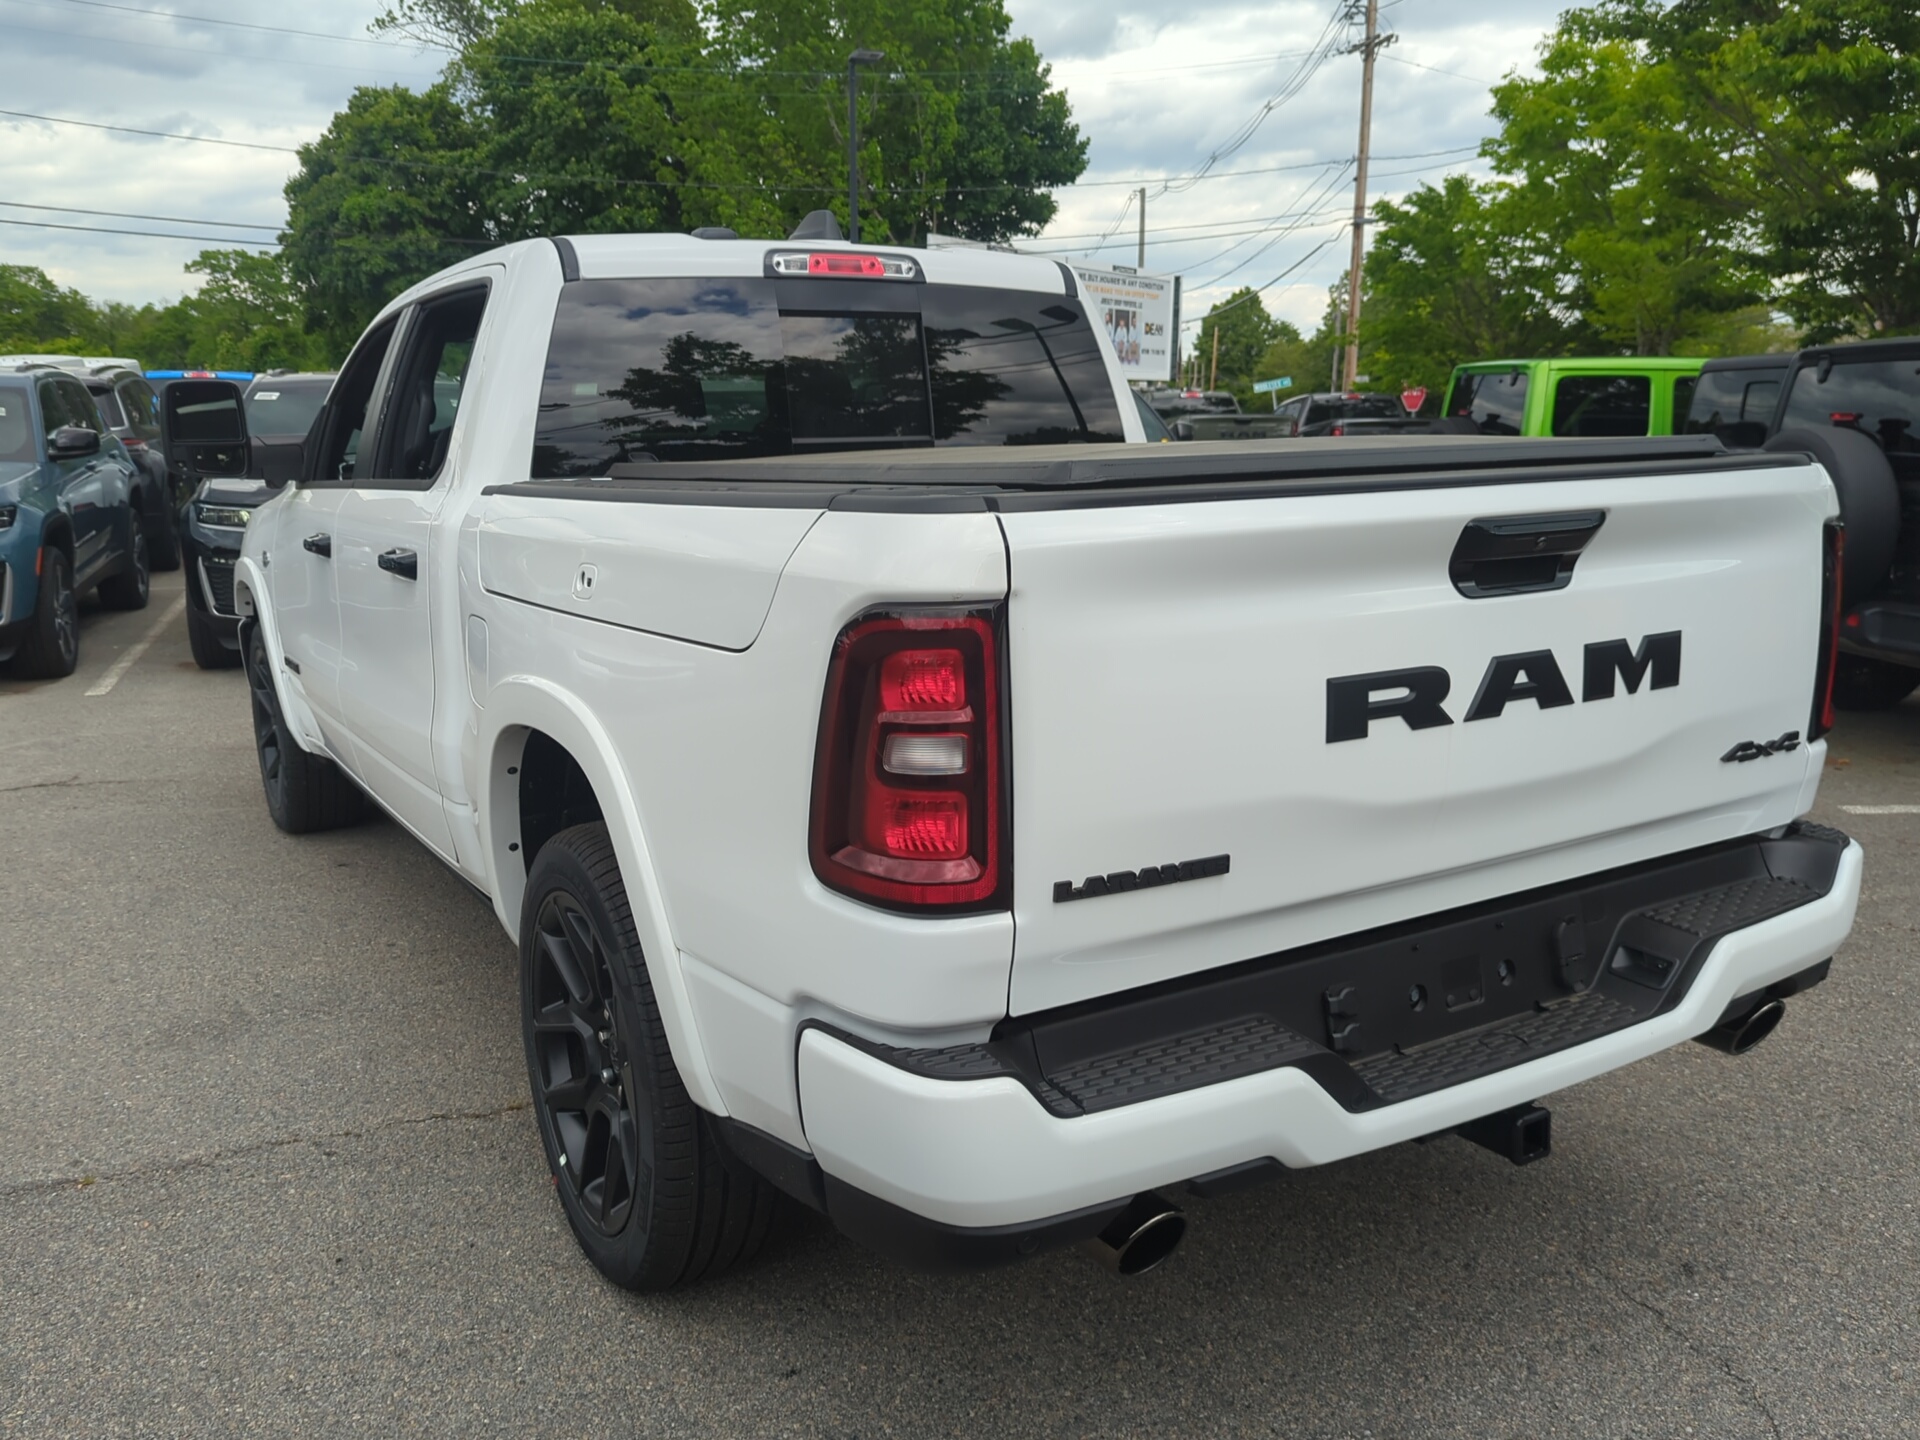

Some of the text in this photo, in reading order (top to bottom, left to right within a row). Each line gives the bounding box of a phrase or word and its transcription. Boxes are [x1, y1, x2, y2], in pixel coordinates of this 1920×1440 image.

[1087, 273, 1099, 282] BUY
[1099, 275, 1121, 286] HOUSES
[1121, 278, 1127, 286] IN
[1127, 279, 1138, 287] ANY
[1138, 280, 1164, 291] CONDITION
[1326, 630, 1682, 743] RAM
[1053, 853, 1230, 903] LARAMIE
